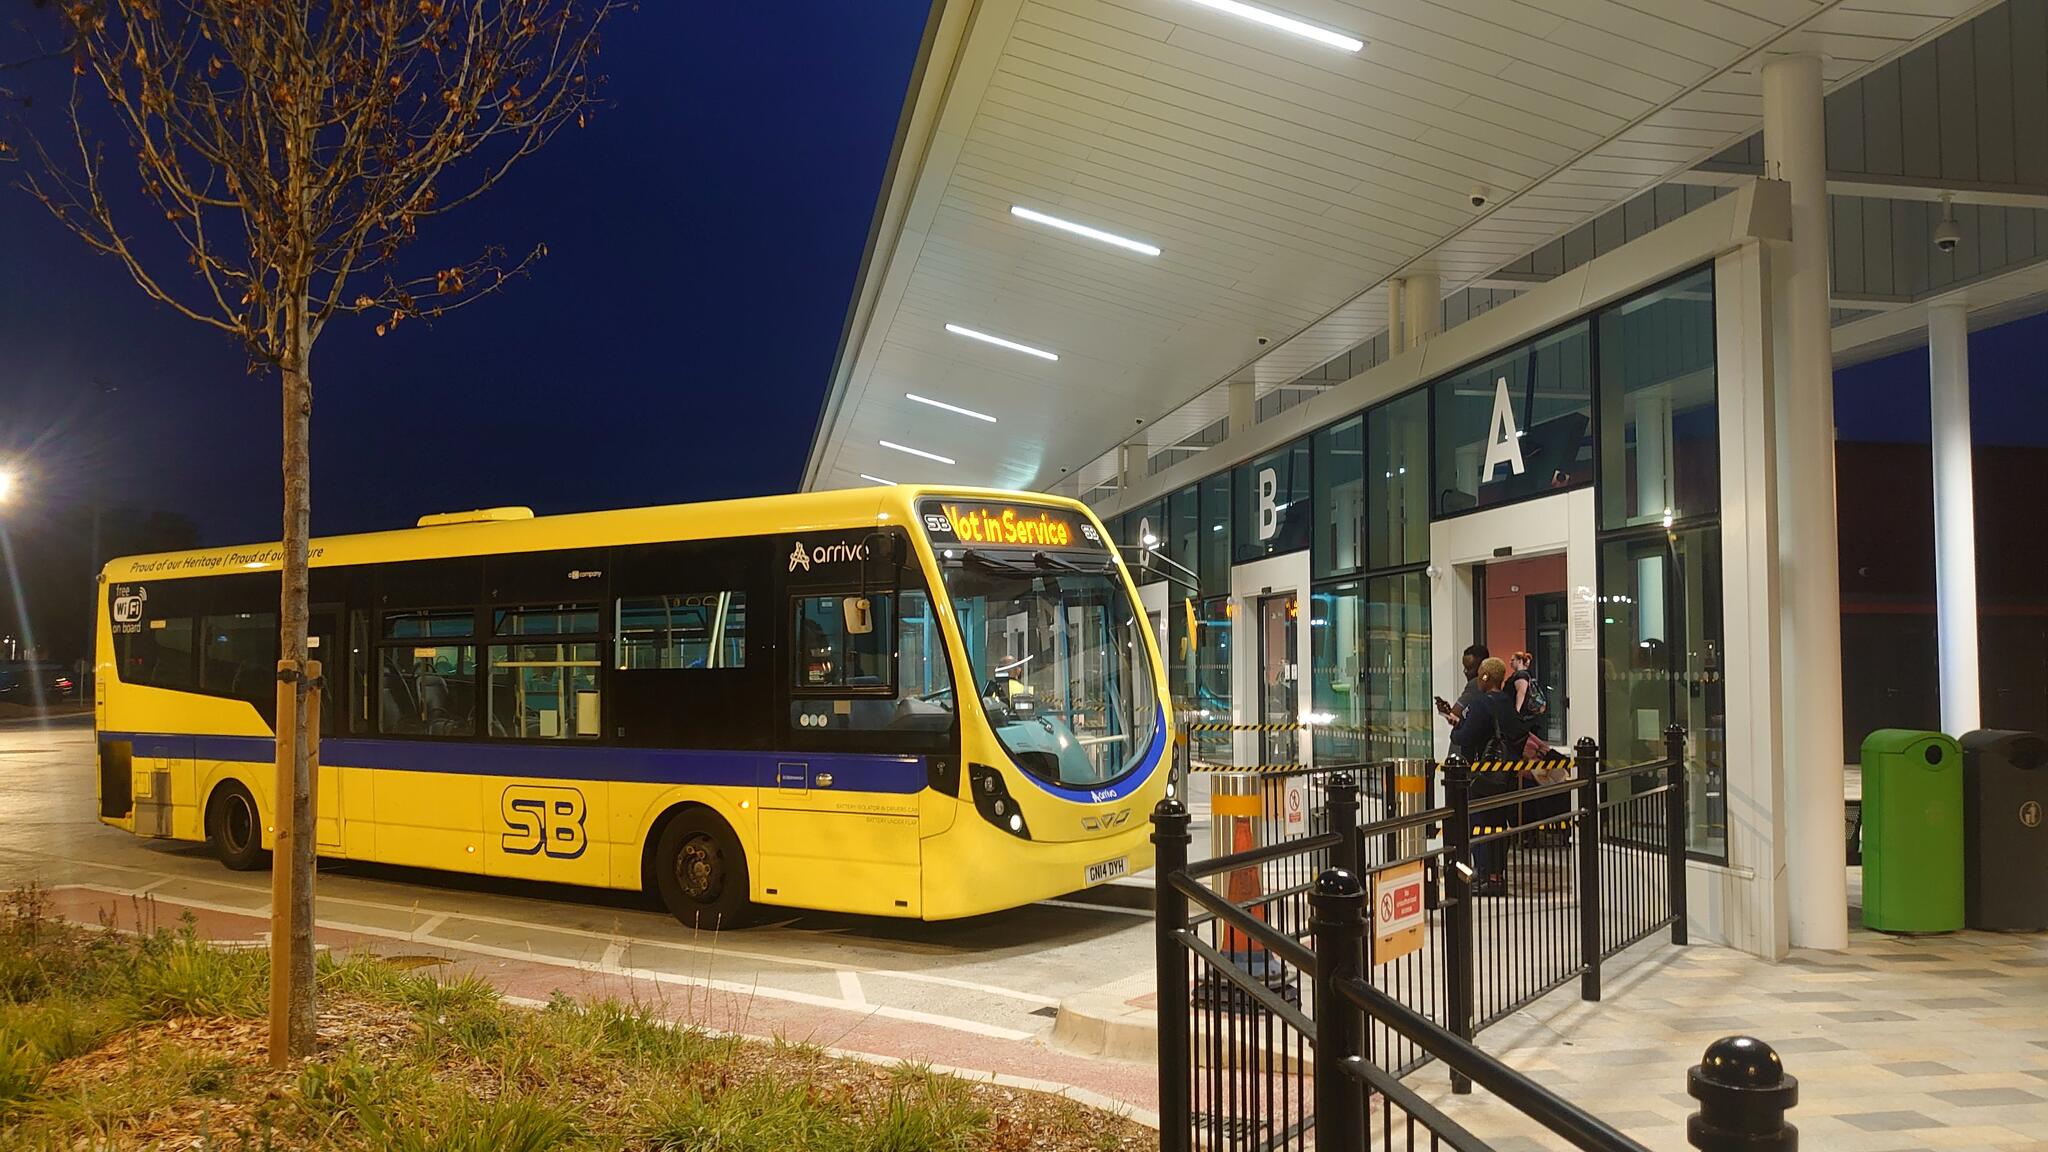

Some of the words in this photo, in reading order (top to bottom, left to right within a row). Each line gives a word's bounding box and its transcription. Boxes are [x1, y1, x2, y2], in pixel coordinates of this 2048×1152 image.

[1482, 376, 1525, 483] A
[1259, 467, 1277, 541] B
[941, 504, 983, 543] Not
[982, 508, 1004, 544] in
[1002, 508, 1069, 546] Service
[130, 560, 158, 573] Proud
[156, 559, 169, 571] of
[167, 559, 182, 571] our
[182, 556, 223, 570] Heritage
[228, 550, 260, 565] Proud
[258, 548, 273, 562] of
[812, 540, 870, 564] arriva
[116, 584, 130, 596] free
[112, 624, 121, 633] on
[122, 621, 141, 633] board
[501, 784, 588, 859] SB
[1089, 866, 1107, 881] GN14
[1108, 859, 1124, 876] DYH
